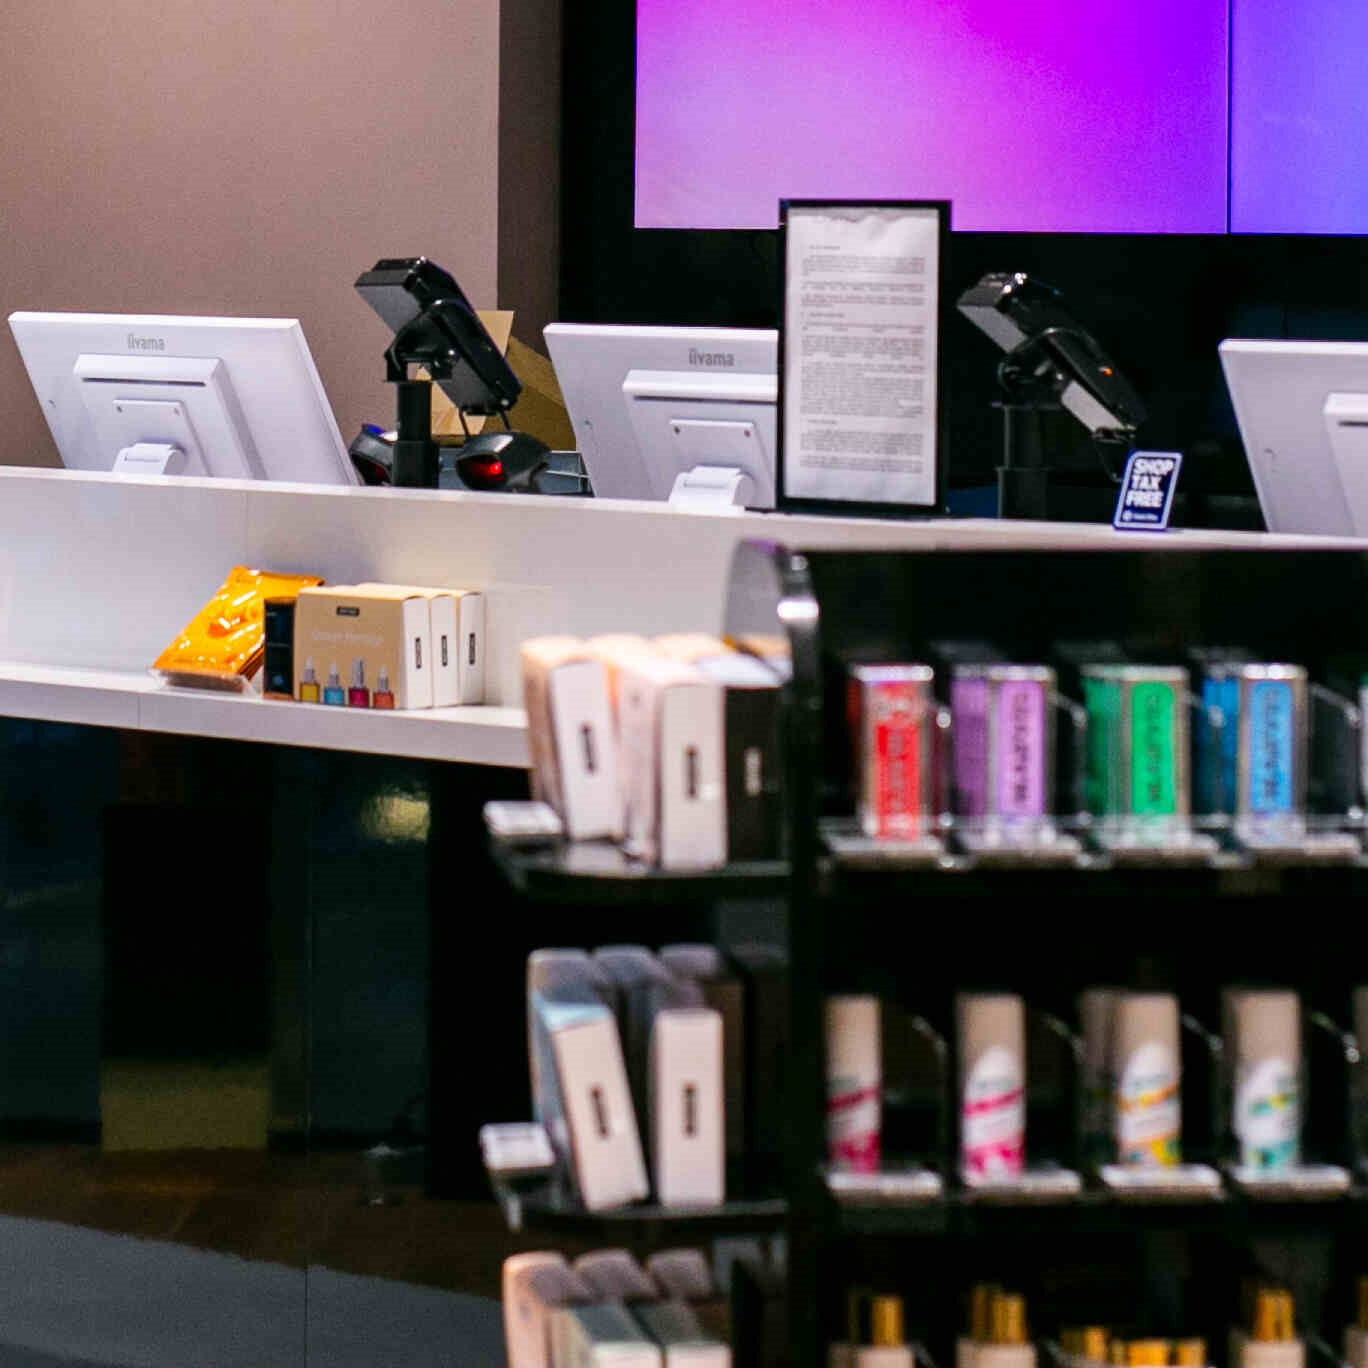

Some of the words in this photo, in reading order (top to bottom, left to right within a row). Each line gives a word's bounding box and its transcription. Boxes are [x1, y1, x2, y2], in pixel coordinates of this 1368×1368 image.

[1133, 459, 1174, 475] SHOP
[1131, 474, 1162, 490] TAX
[1126, 490, 1164, 508] FREE
